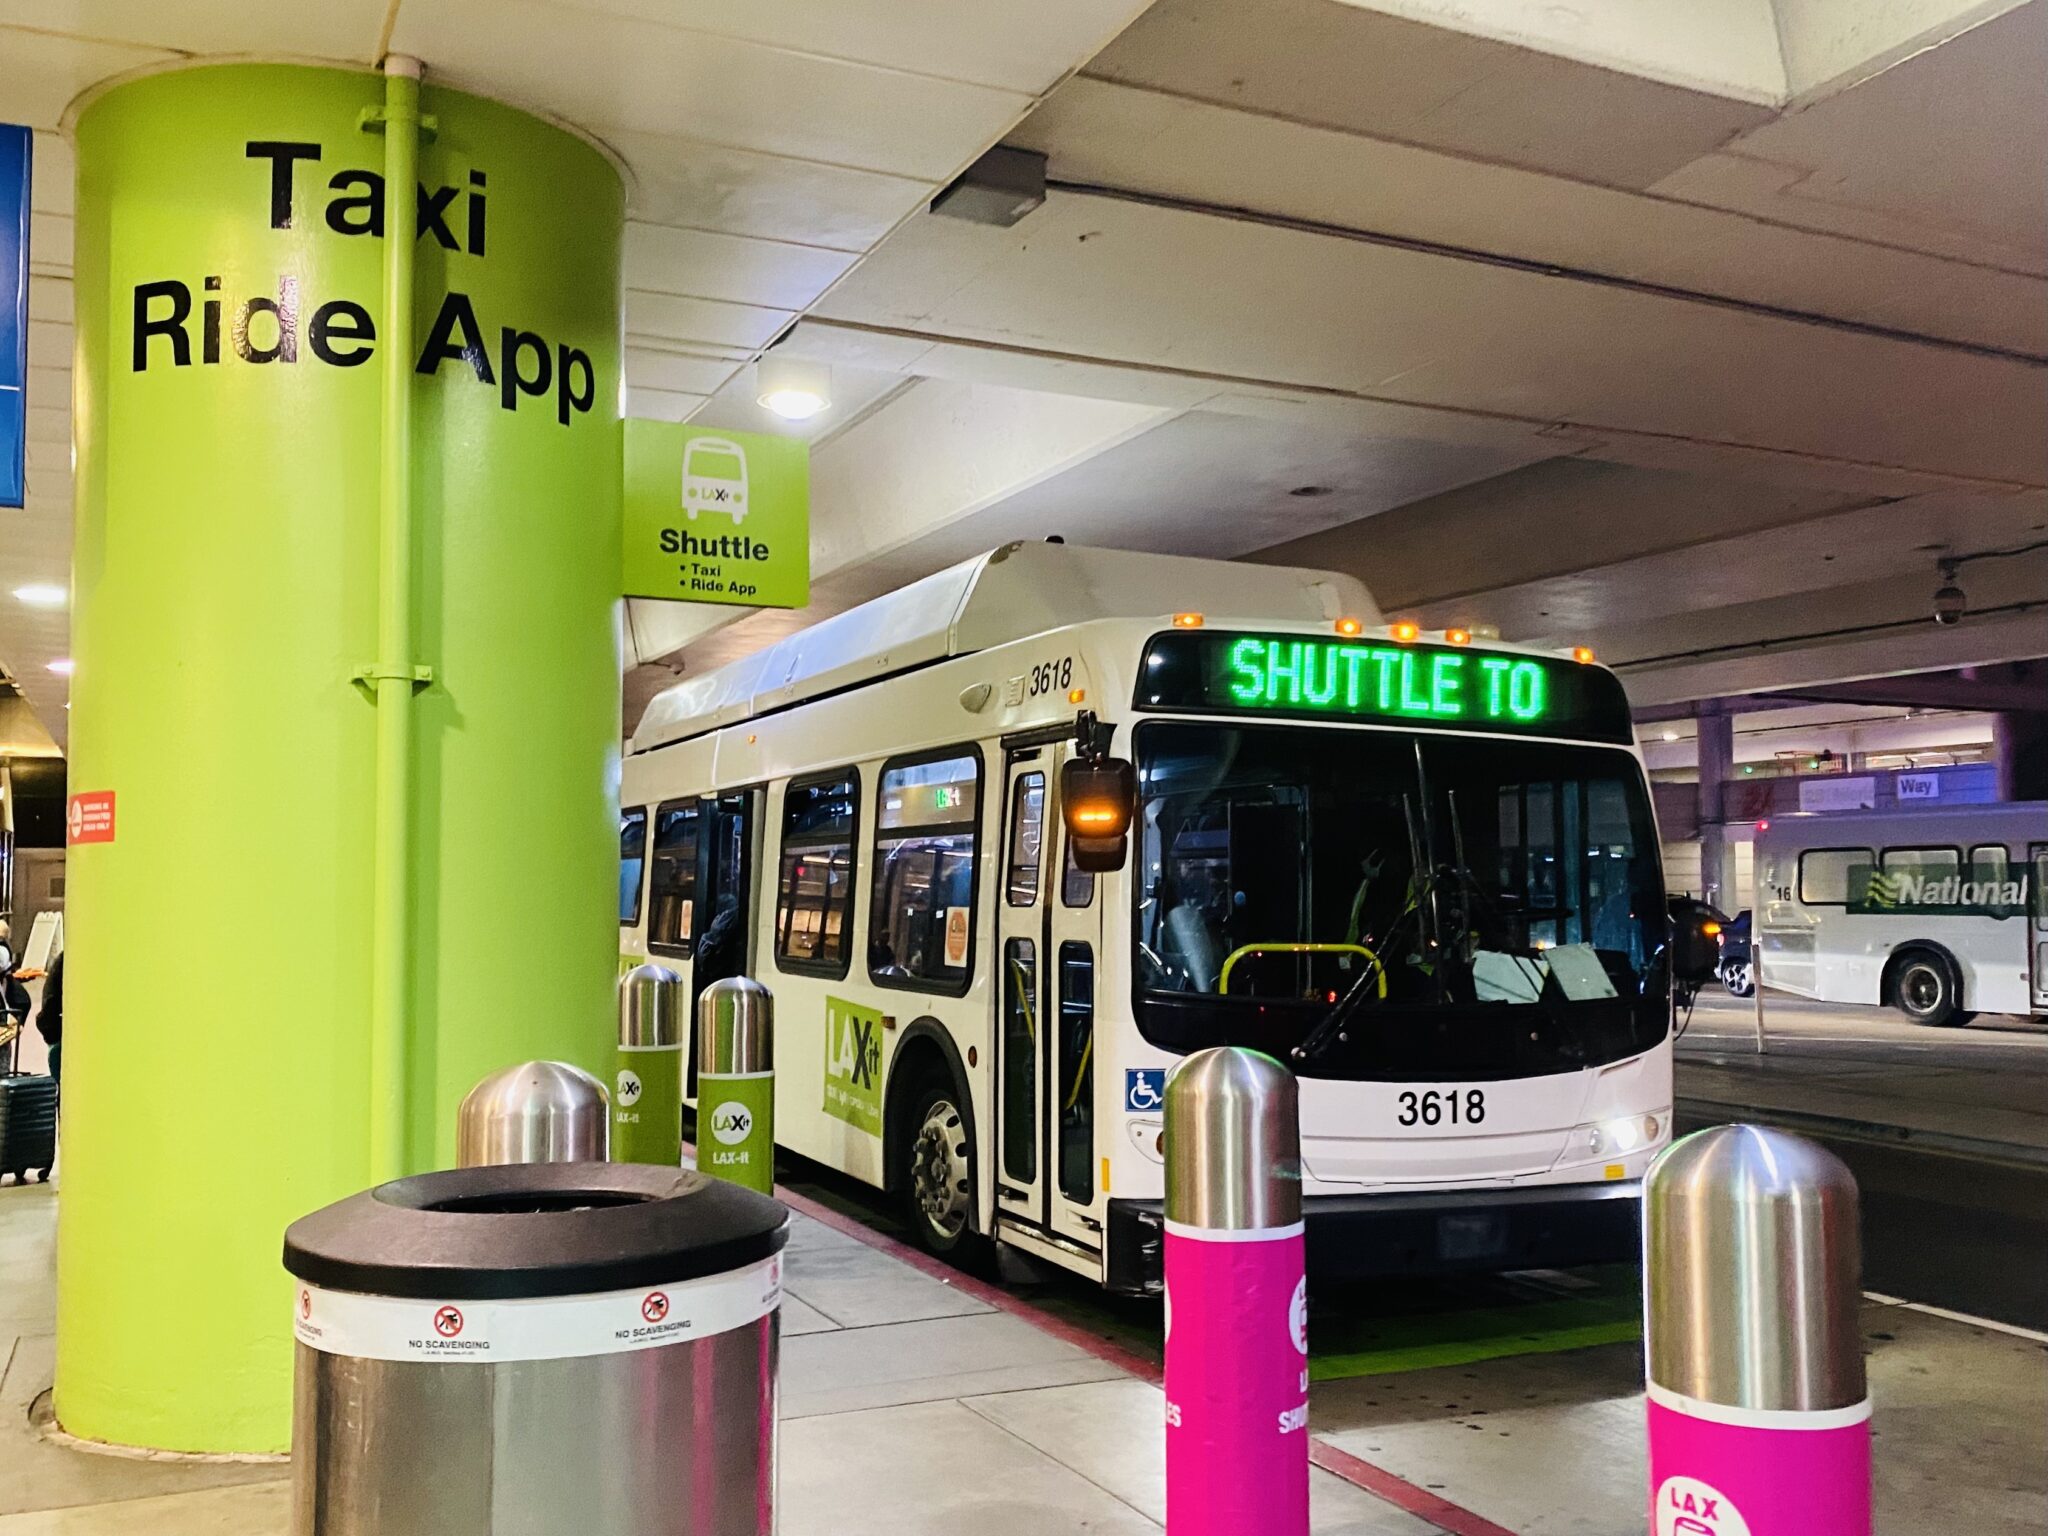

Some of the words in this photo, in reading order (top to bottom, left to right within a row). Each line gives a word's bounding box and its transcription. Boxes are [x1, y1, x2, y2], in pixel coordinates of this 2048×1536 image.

[246, 141, 486, 256] Taxi
[133, 275, 376, 371] Ride
[415, 292, 595, 425] App
[660, 528, 769, 561] Shuttle
[691, 563, 721, 577] Taxi
[691, 578, 723, 592] Ride
[729, 581, 756, 596] App
[1030, 656, 1072, 696] 3618
[1230, 639, 1462, 714] SHUTTLE
[1482, 658, 1546, 720] TO
[1900, 778, 1932, 795] Way
[1900, 873, 2028, 906] National
[1398, 1090, 1485, 1126] 3618
[409, 1340, 422, 1348] NO
[425, 1340, 490, 1349] SCAVENGING
[616, 1330, 630, 1339] NO
[633, 1320, 691, 1337] SCAVENGING
[1671, 1487, 1719, 1521] LAX
